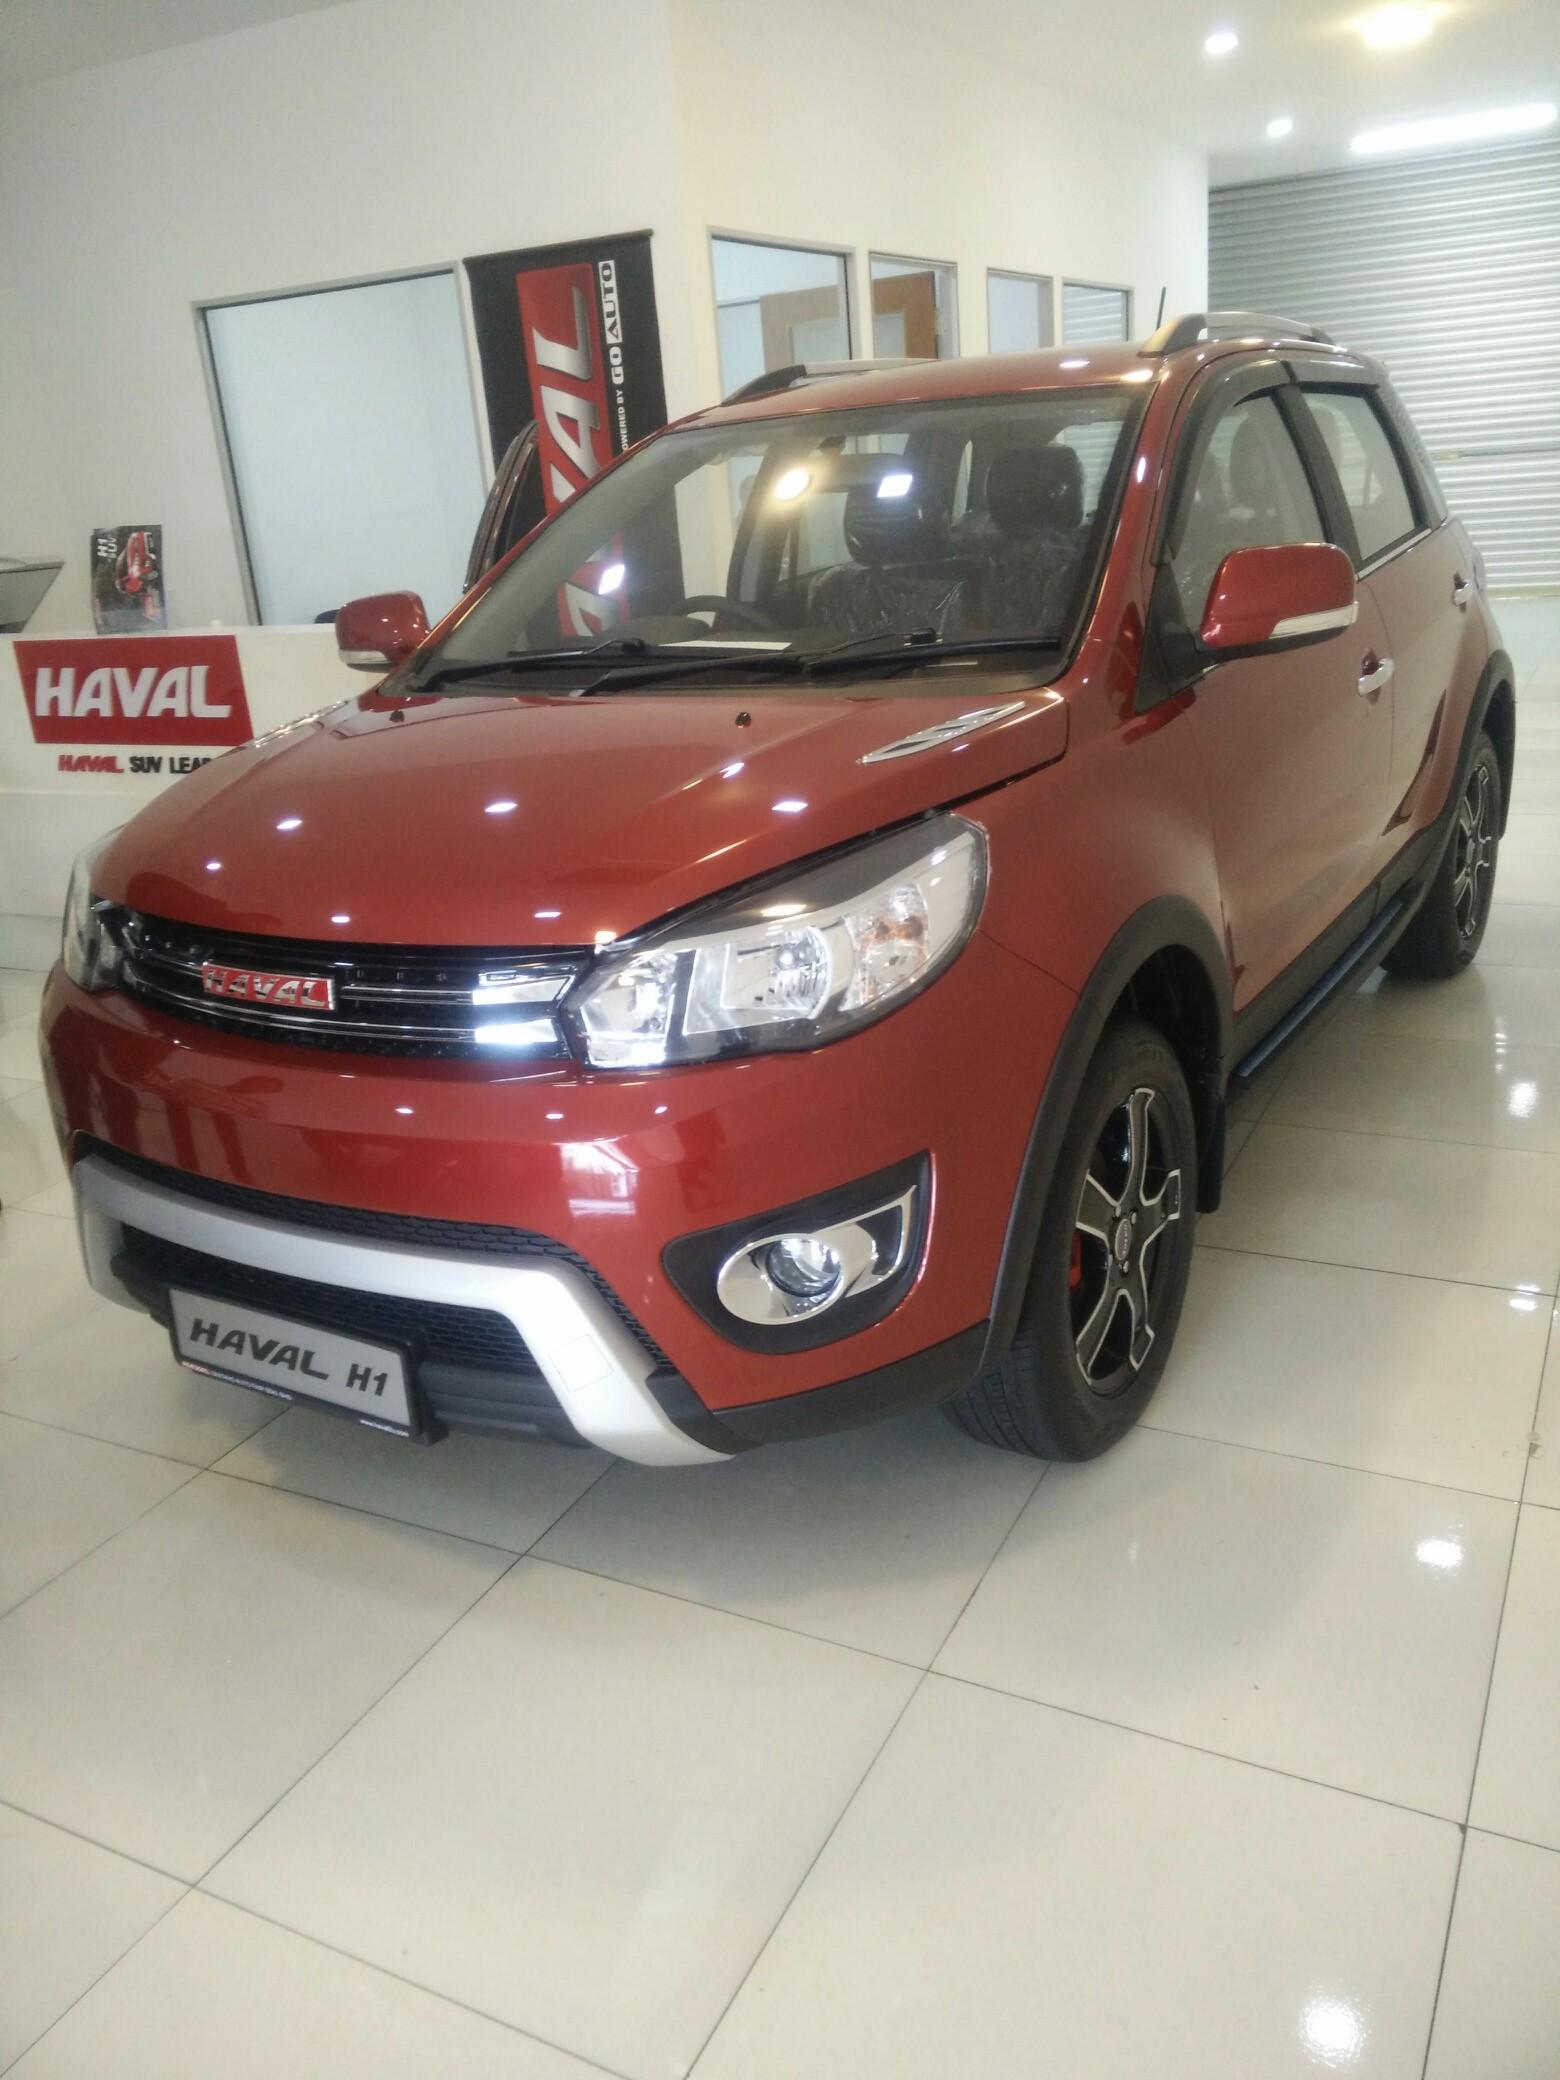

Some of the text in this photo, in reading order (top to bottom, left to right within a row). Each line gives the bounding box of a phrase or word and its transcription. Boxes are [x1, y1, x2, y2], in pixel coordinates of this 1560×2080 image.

[600, 261, 629, 451] OWERED BY GO AUTO
[35, 666, 232, 718] HAVAL
[58, 755, 124, 774] HAVAL
[129, 756, 162, 774] SUV
[204, 968, 328, 1007] HAVAL
[190, 1318, 329, 1381] HAVAL
[346, 1363, 388, 1396] H1
